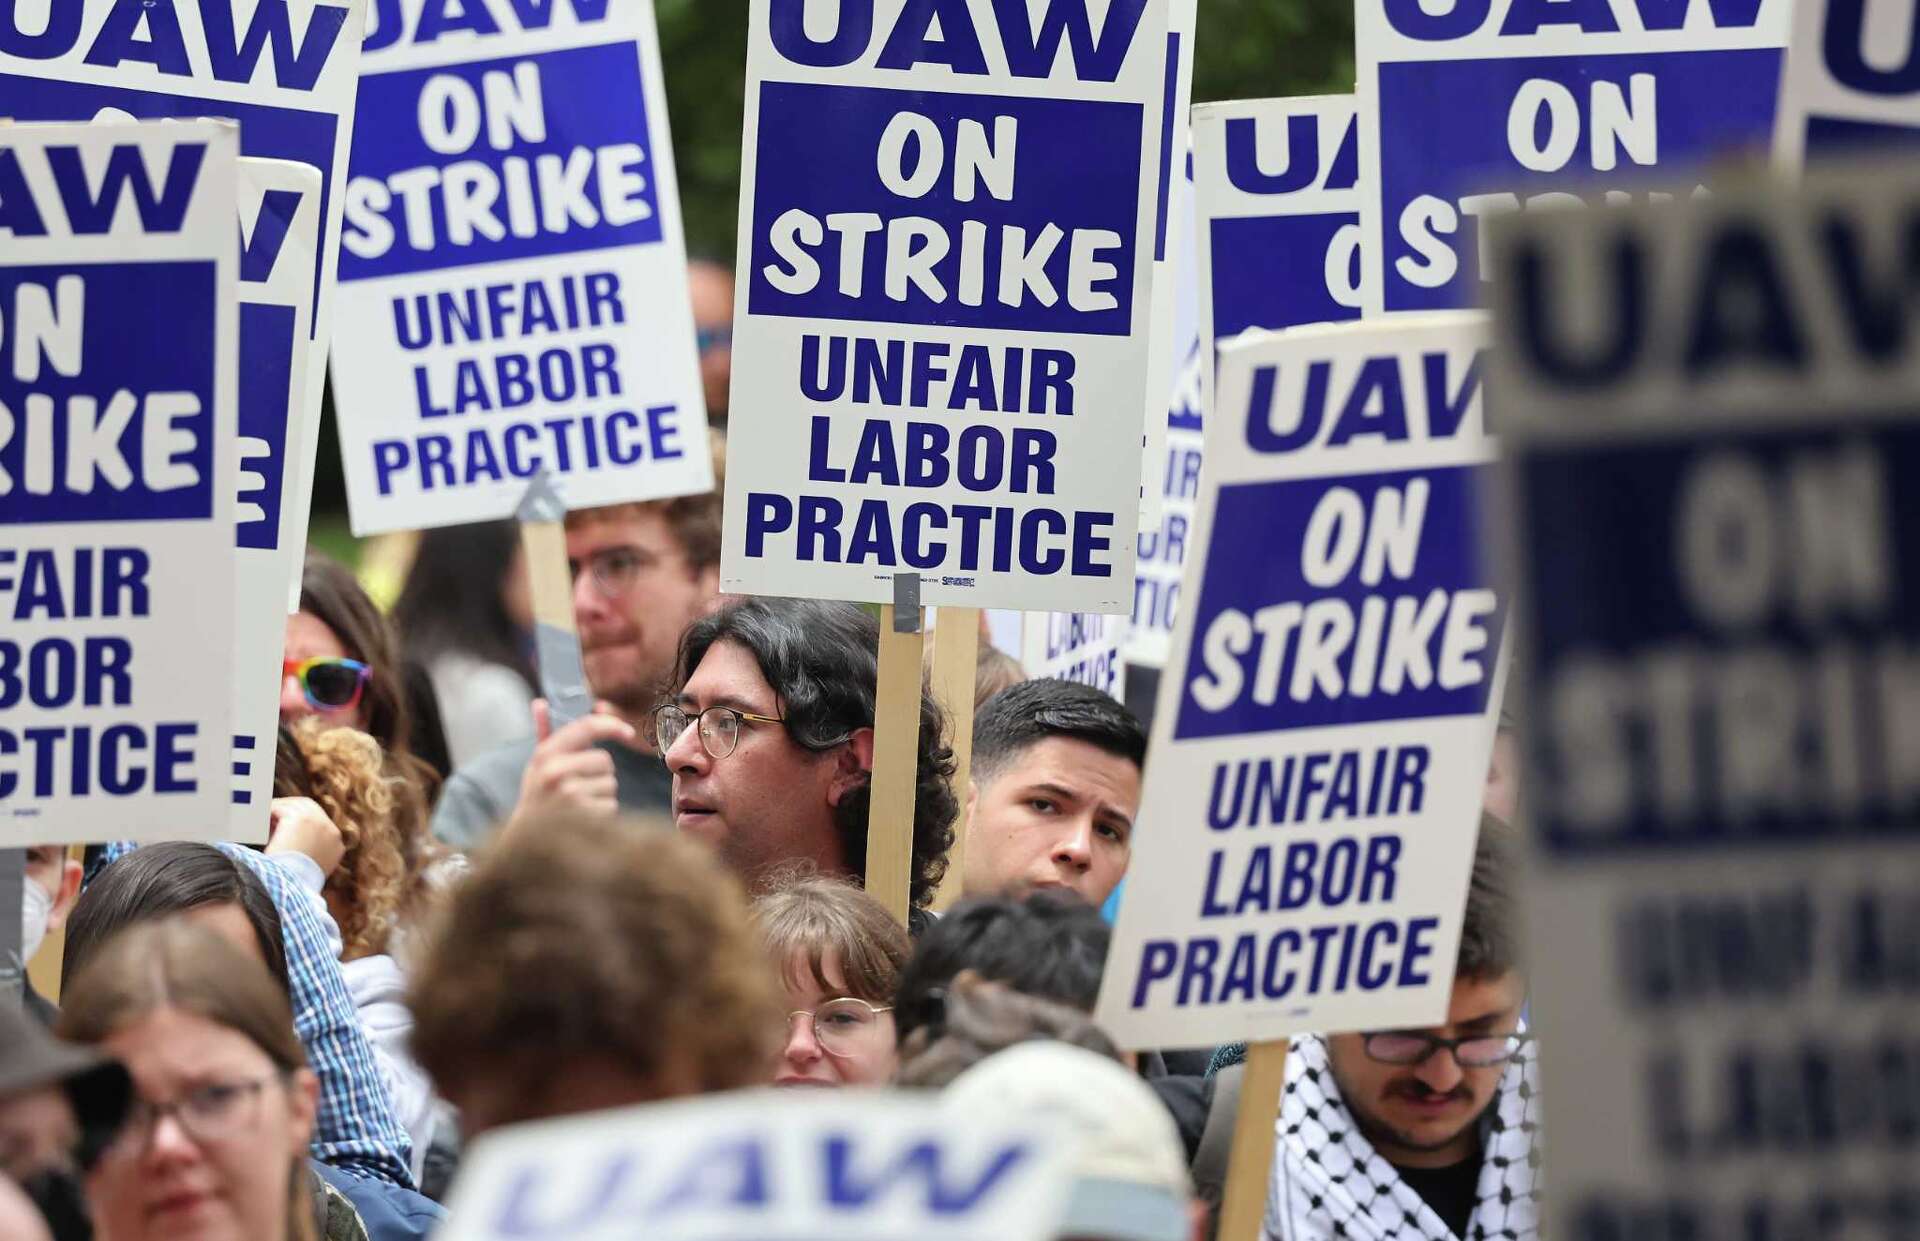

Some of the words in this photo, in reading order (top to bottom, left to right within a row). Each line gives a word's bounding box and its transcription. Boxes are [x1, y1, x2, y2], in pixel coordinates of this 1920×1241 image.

[0, 0, 349, 92] UAW
[769, 0, 1147, 82] UAW
[418, 61, 546, 154] ON
[1507, 74, 1656, 171] ON
[342, 143, 652, 258] STRIKE
[877, 111, 1017, 202] ON
[763, 208, 1122, 312] STRIKE
[392, 272, 624, 351] UNFAIR
[414, 344, 622, 419] LABOR
[799, 335, 1076, 416] UNFAIR
[373, 406, 683, 496] PRACTICE
[808, 416, 1057, 495] LABOR
[744, 493, 1114, 577] PRACTICE
[1301, 477, 1430, 588] ON
[1191, 589, 1497, 711] STRIKE
[1207, 744, 1430, 832] UNFAIR
[1201, 835, 1402, 919] LABOR
[1131, 917, 1439, 1010] PRACTICE
